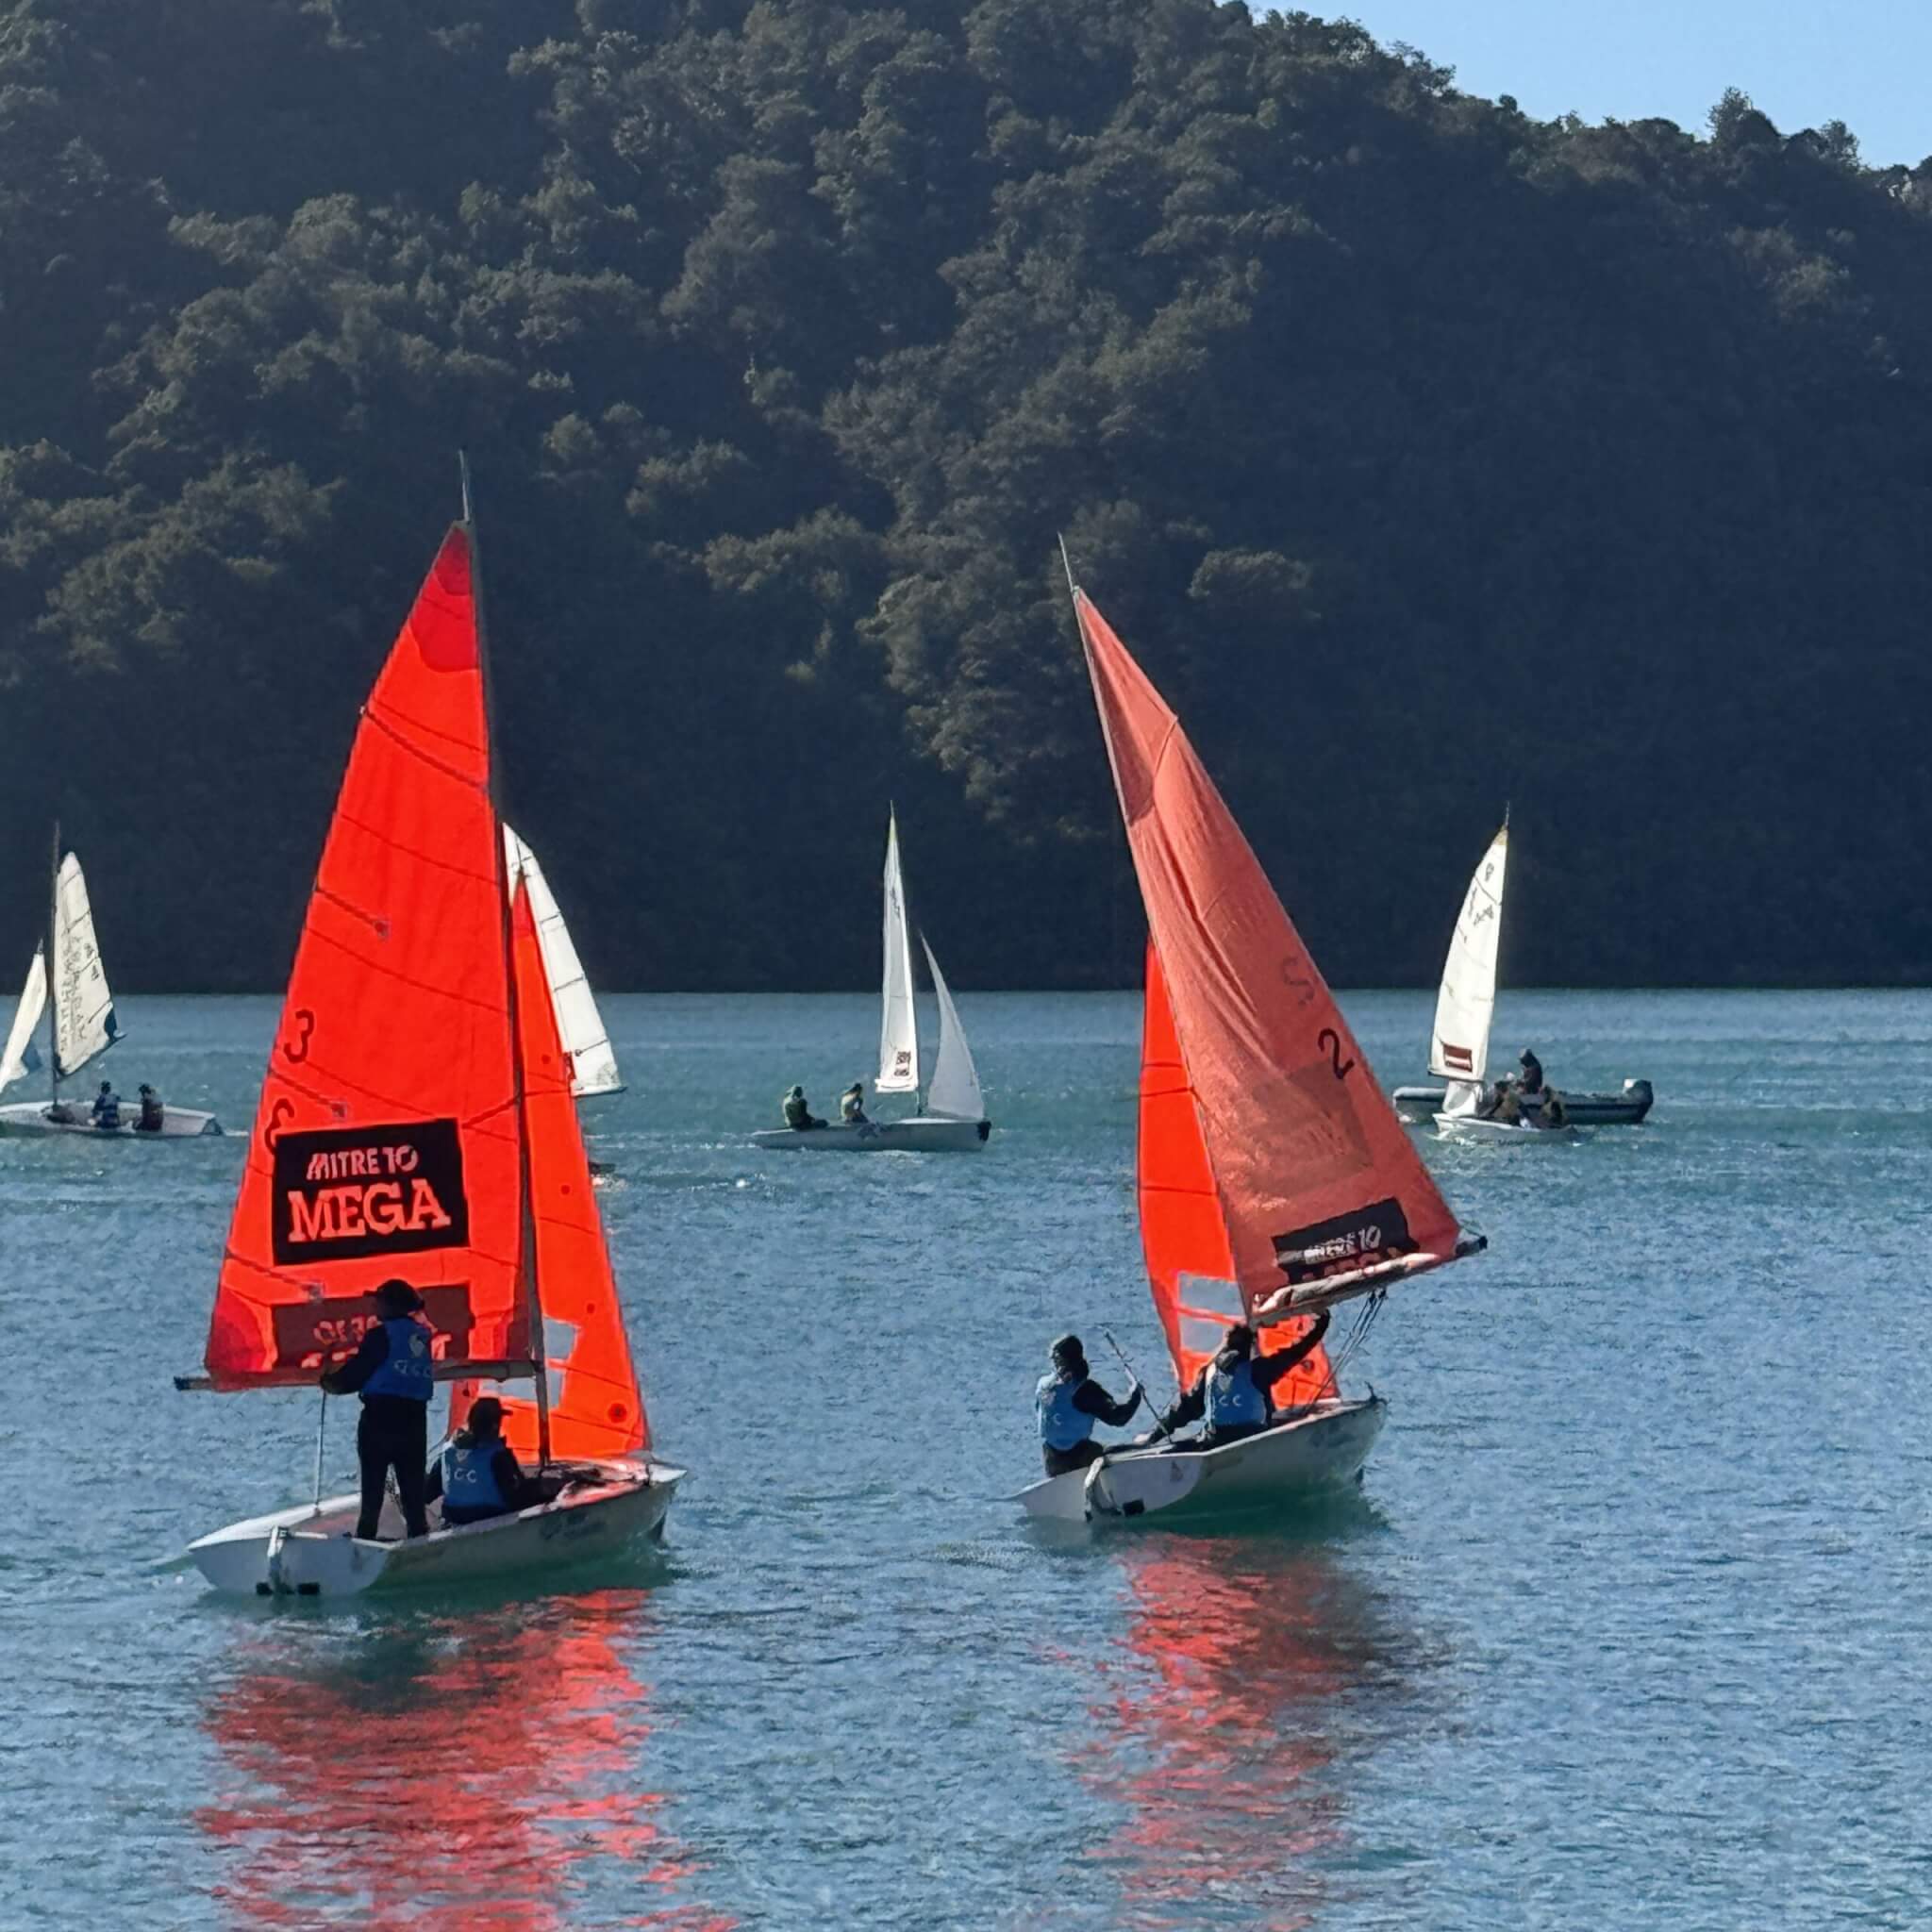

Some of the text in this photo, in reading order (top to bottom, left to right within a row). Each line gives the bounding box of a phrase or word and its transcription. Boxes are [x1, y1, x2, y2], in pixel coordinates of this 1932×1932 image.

[284, 1008, 315, 1064] 3
[1317, 1027, 1356, 1080] 2
[306, 1144, 419, 1180] MITRE 10
[287, 1178, 452, 1243] MEGA
[1358, 1225, 1381, 1250] 10
